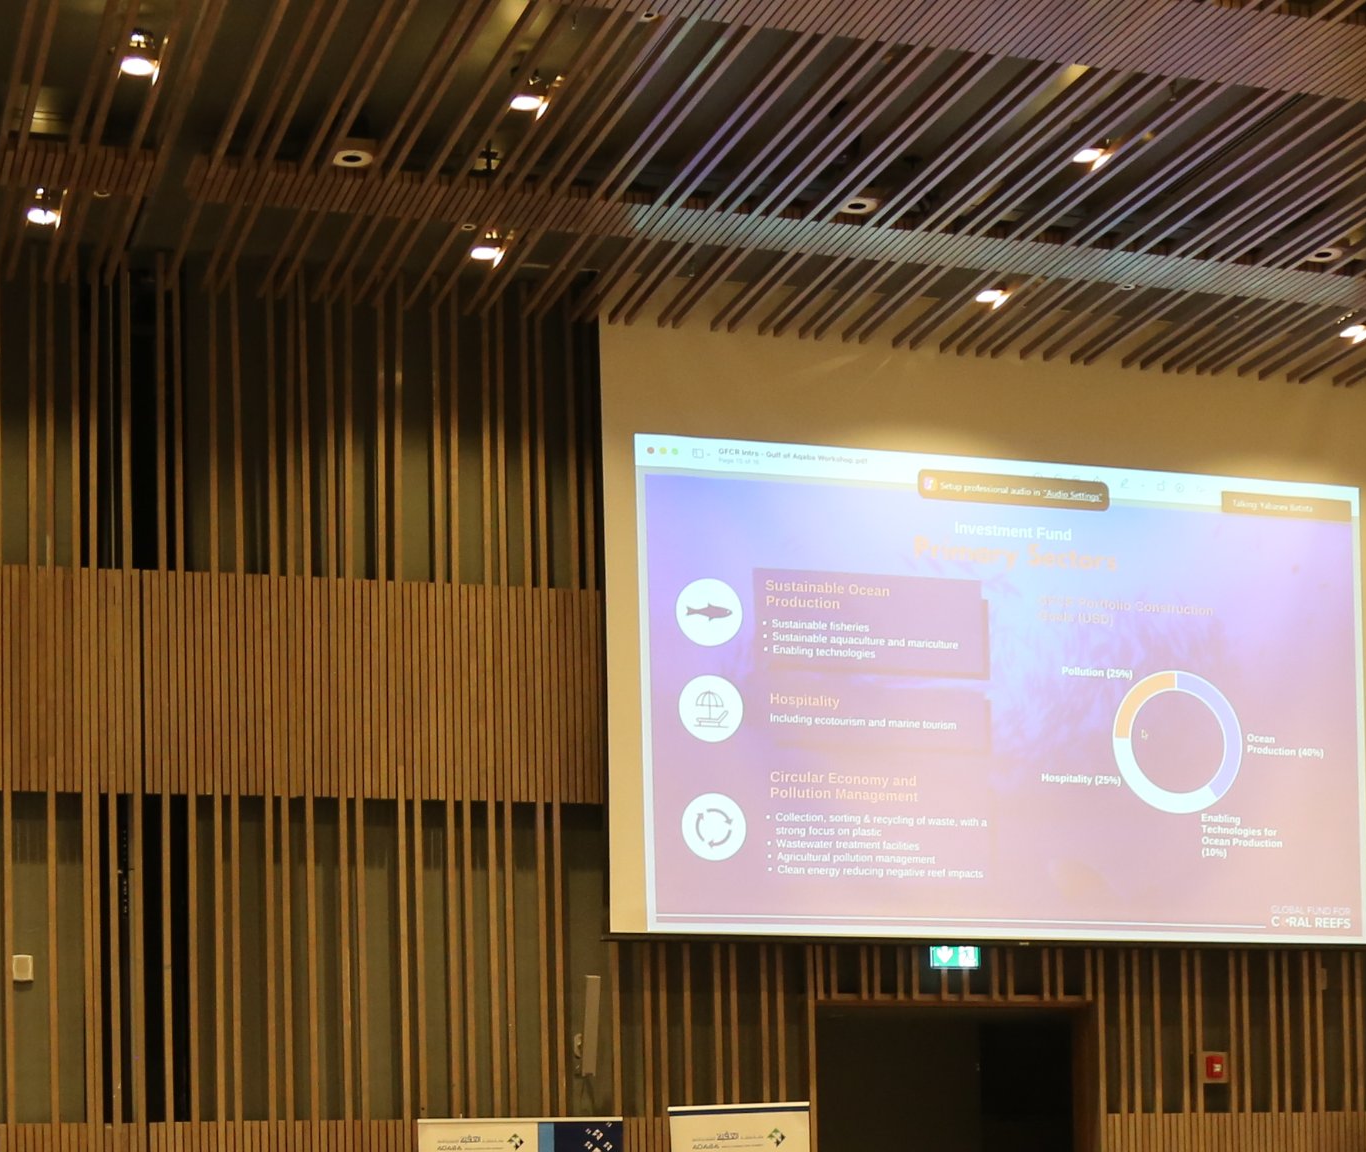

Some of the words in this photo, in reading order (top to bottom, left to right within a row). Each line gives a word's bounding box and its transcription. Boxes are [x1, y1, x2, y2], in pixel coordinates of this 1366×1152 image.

[939, 482, 961, 491] Setup
[963, 483, 1008, 494] professional
[1010, 487, 1031, 495] audio
[1033, 488, 1040, 496] in
[954, 521, 1032, 538] Investment
[1036, 526, 1072, 541] Fund
[913, 535, 1018, 571] Primary
[1026, 543, 1117, 572] Sectors
[765, 579, 843, 594] Sustainable
[848, 584, 890, 597] Ocean
[766, 594, 840, 610] Production
[1134, 600, 1214, 615] Construction
[771, 618, 827, 630] Sustainable
[829, 621, 869, 632] fisheries
[772, 631, 827, 643] Sustainable
[830, 634, 885, 648] aquaculture
[887, 637, 905, 647] and
[907, 638, 958, 649] mariculture
[772, 644, 812, 658] Enabling
[815, 647, 875, 660] technologies
[1061, 666, 1103, 677] Pollution
[1106, 668, 1132, 679] (25%)
[770, 693, 840, 710] Hospitality
[770, 712, 812, 726] Including
[814, 715, 865, 727] ecotourism
[868, 717, 885, 727] and
[888, 718, 920, 728] marine
[922, 719, 956, 730] tourism
[1246, 733, 1275, 744] Ocean
[1247, 744, 1296, 756] Production
[1298, 747, 1324, 759] (40%)
[770, 770, 824, 784] Circular
[828, 773, 889, 788] Economy
[892, 775, 916, 787] and
[1041, 772, 1092, 785] Hospitality
[1094, 774, 1121, 787] (25%)
[770, 785, 830, 800] Pollution
[835, 788, 918, 804] Management
[775, 811, 826, 823] Collection,
[829, 813, 861, 824] sorting
[863, 814, 870, 823] &
[873, 814, 913, 827] recycling
[916, 816, 926, 825] of
[928, 817, 958, 827] waste,
[960, 817, 979, 827] with
[1200, 813, 1241, 825] Enabling
[776, 826, 805, 836] strong
[808, 825, 835, 835] focus
[852, 827, 882, 837] plastic
[1200, 824, 1261, 836] Technologies
[1263, 826, 1277, 837] for
[776, 838, 833, 849] Wastewater
[835, 839, 880, 850] treatment
[882, 840, 919, 851] facilities
[1201, 836, 1230, 847] Ocean
[1232, 837, 1282, 848] Production
[777, 851, 830, 862] Agricultural
[832, 852, 873, 864] pollution
[875, 855, 935, 865] management
[1201, 847, 1227, 858] (10%)
[777, 864, 804, 874] Clean
[807, 866, 840, 877] energy
[843, 866, 884, 878] reducing
[886, 867, 924, 878] negative
[927, 868, 946, 877] reef
[948, 868, 983, 879] impacts
[1314, 917, 1351, 929] REEFS
